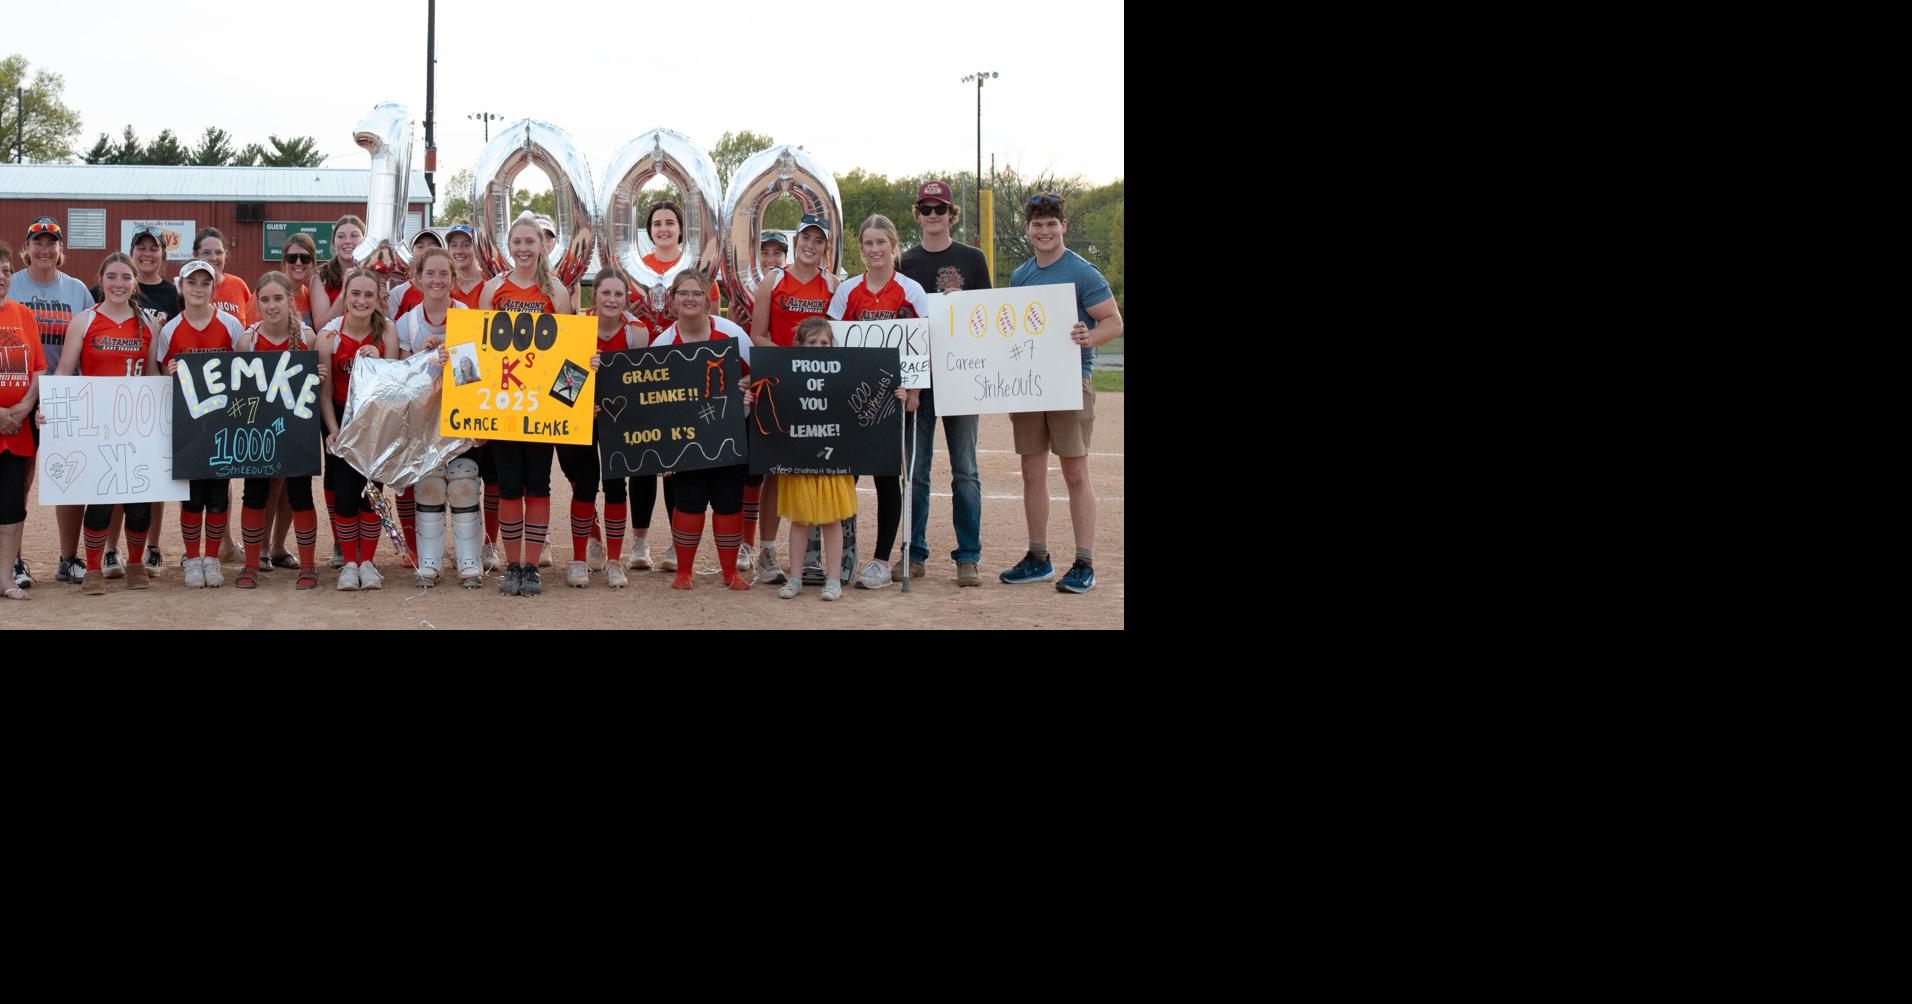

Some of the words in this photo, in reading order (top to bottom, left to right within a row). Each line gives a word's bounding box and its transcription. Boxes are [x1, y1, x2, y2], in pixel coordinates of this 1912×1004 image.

[503, 299, 546, 309] ALTAMONT
[787, 296, 827, 309] ALTAMONT
[949, 301, 1047, 338] 1000
[482, 311, 558, 352] 1000
[101, 336, 143, 347] ALTAMONT
[1009, 339, 1034, 361] #7
[125, 357, 145, 376] 16
[791, 359, 842, 374] PROUD
[900, 360, 929, 373] RACE
[946, 352, 988, 371] Career
[176, 350, 321, 420] LEMKE
[622, 367, 671, 385] GRACE
[806, 378, 825, 391] OF
[901, 374, 919, 386] #7
[974, 369, 1042, 401] Strikeouts
[477, 387, 539, 413] 2025
[799, 397, 828, 411] YOU
[847, 381, 872, 414] 1000
[227, 396, 260, 424] #7
[698, 395, 728, 424] #7
[449, 408, 498, 432] GRACE
[523, 415, 570, 436] LEMKE
[789, 423, 841, 438] LEMKE!
[623, 428, 662, 446] 1,000
[671, 426, 696, 441] K'S
[50, 461, 79, 484] #7
